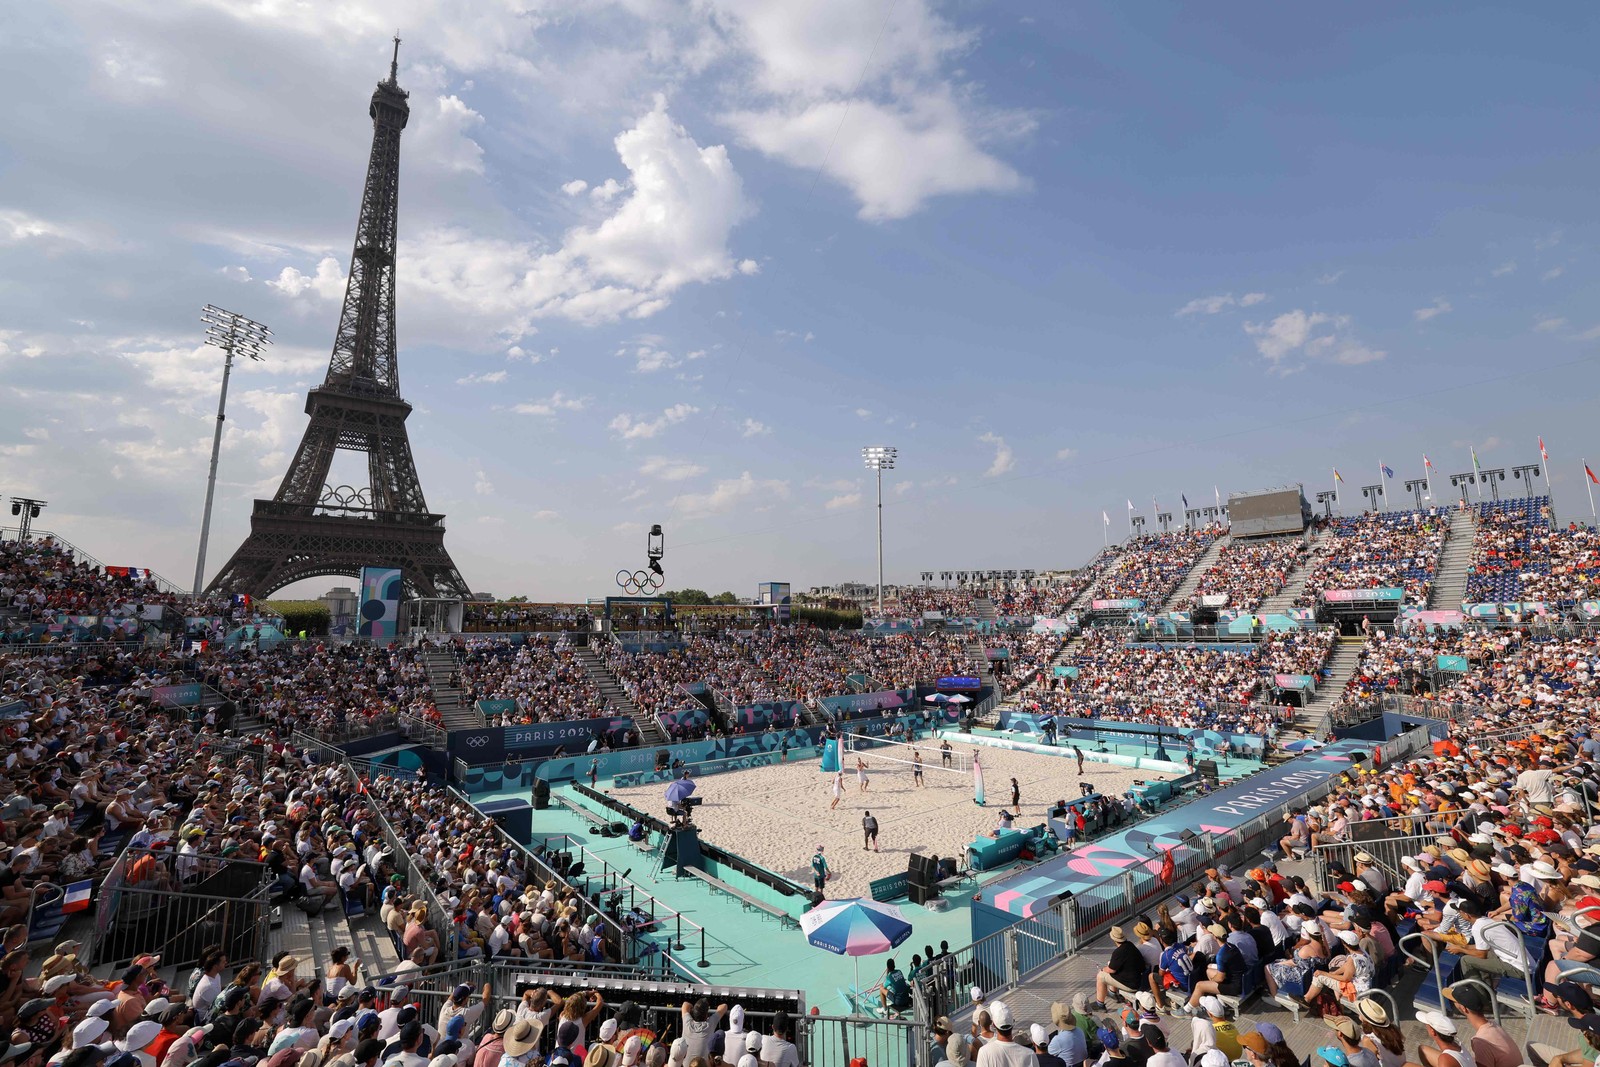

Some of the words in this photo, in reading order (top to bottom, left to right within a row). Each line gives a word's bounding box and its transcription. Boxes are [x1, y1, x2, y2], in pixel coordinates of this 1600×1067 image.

[852, 699, 873, 707] PARIS
[516, 730, 555, 742] PARIS
[560, 727, 592, 739] 2024
[1139, 734, 1170, 742] 204
[630, 752, 654, 764] PAR
[670, 748, 698, 760] 2024
[1212, 787, 1288, 816] PARIS
[1270, 769, 1331, 789] 2024
[874, 884, 892, 894] PARIS
[814, 940, 828, 948] PARIS
[828, 944, 840, 952] 2024
[1178, 954, 1194, 976] 10
